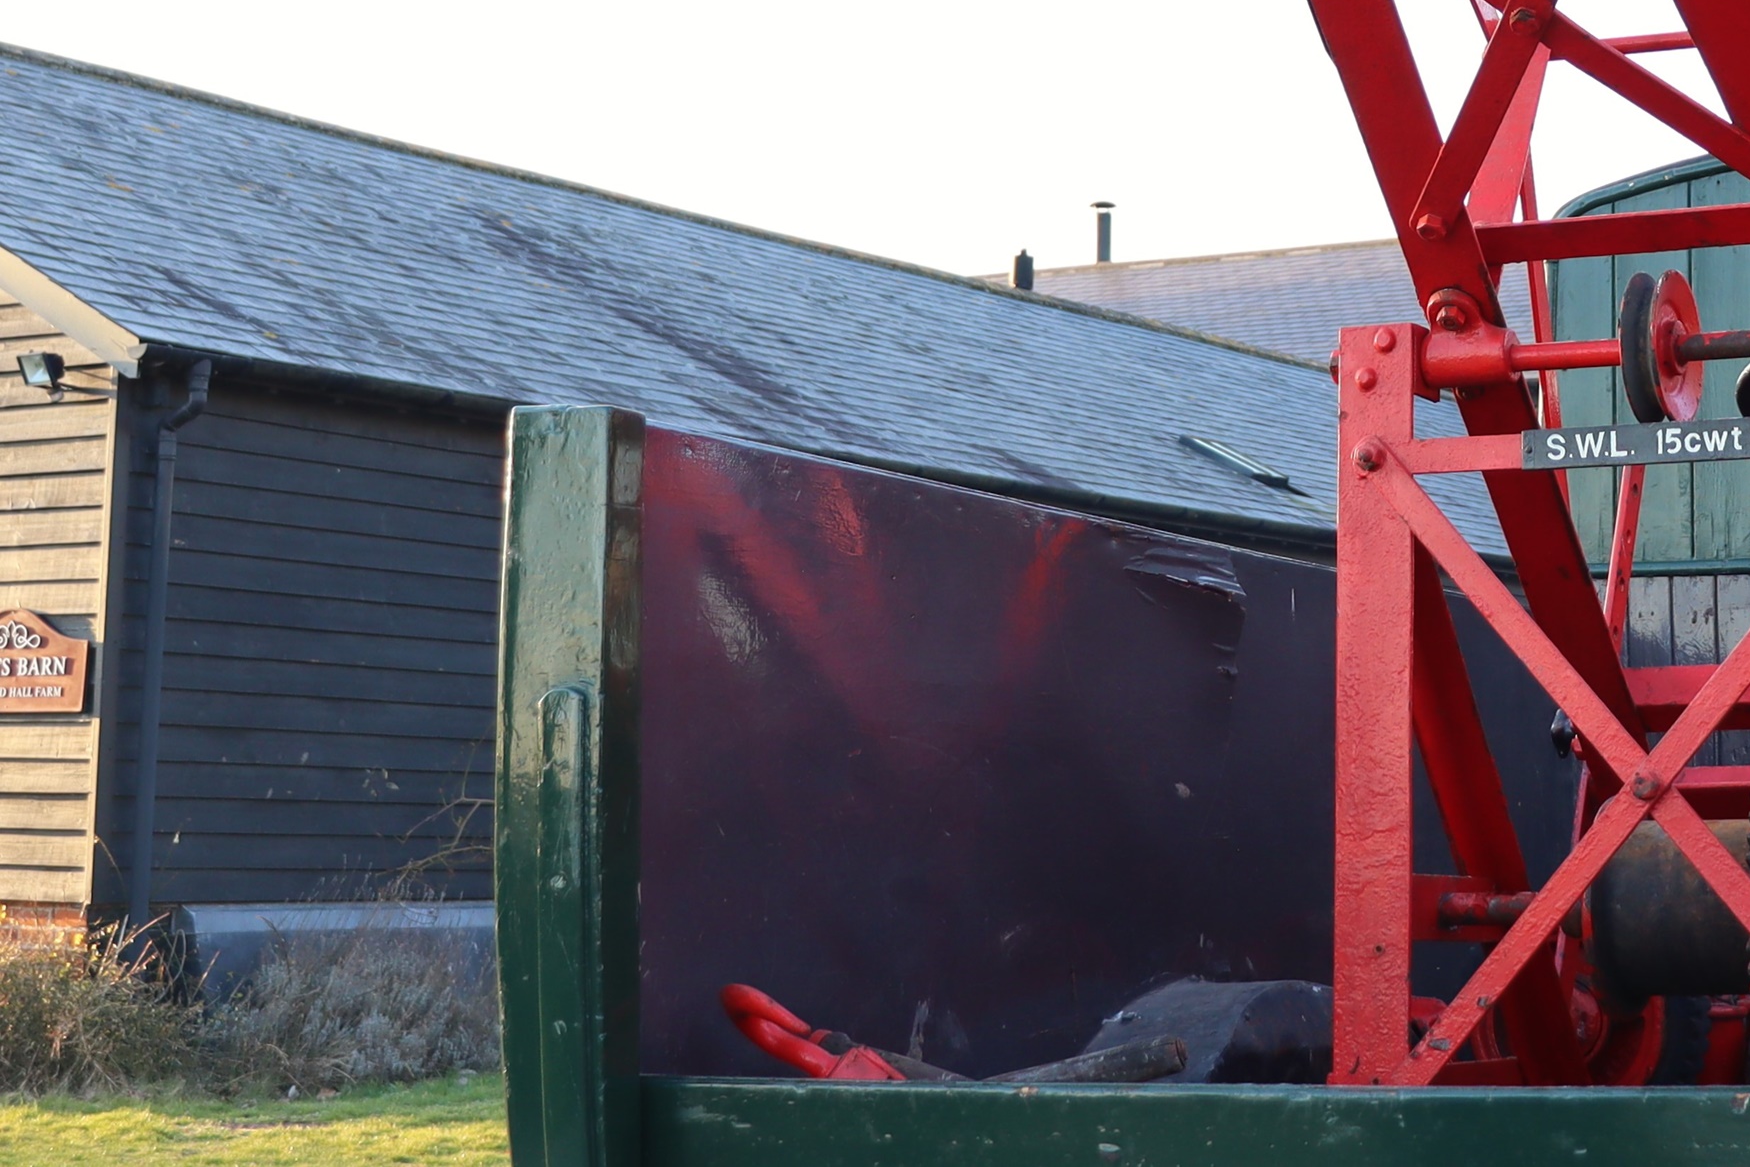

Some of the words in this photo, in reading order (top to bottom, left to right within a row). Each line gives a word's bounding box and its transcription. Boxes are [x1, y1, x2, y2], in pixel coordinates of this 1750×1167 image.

[1546, 430, 1635, 461] S.W.L.
[1655, 426, 1743, 455] 15cwt
[16, 656, 67, 676] BARN
[9, 686, 33, 698] HALL
[35, 686, 62, 698] FARM
